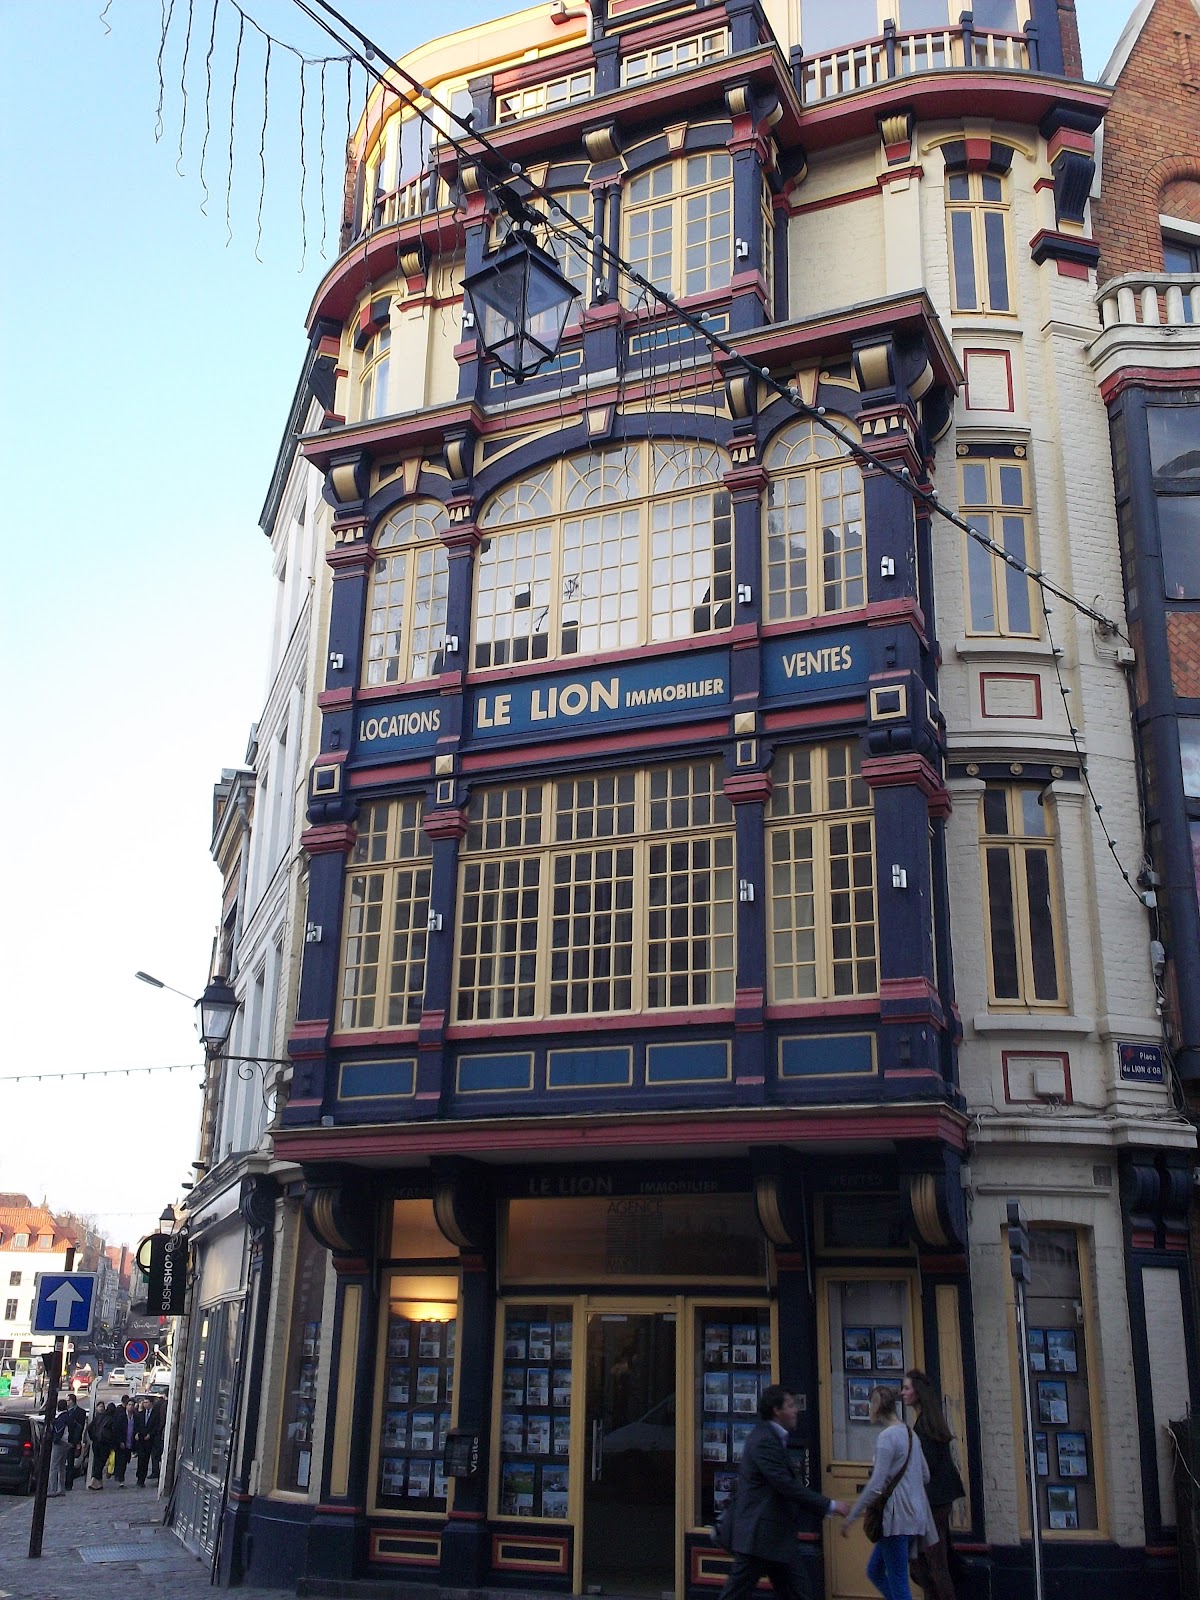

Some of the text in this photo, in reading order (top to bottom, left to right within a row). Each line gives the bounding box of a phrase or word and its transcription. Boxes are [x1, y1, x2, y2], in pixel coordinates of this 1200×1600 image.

[782, 644, 852, 678] VENTES
[477, 677, 724, 729] LE LION IMMOBILIER
[359, 709, 441, 742] LOCATIONS
[1122, 1064, 1130, 1073] du
[1131, 1065, 1146, 1074] LION
[1139, 1051, 1156, 1061] Place
[529, 1175, 719, 1195] LE LION IMMOBILIER
